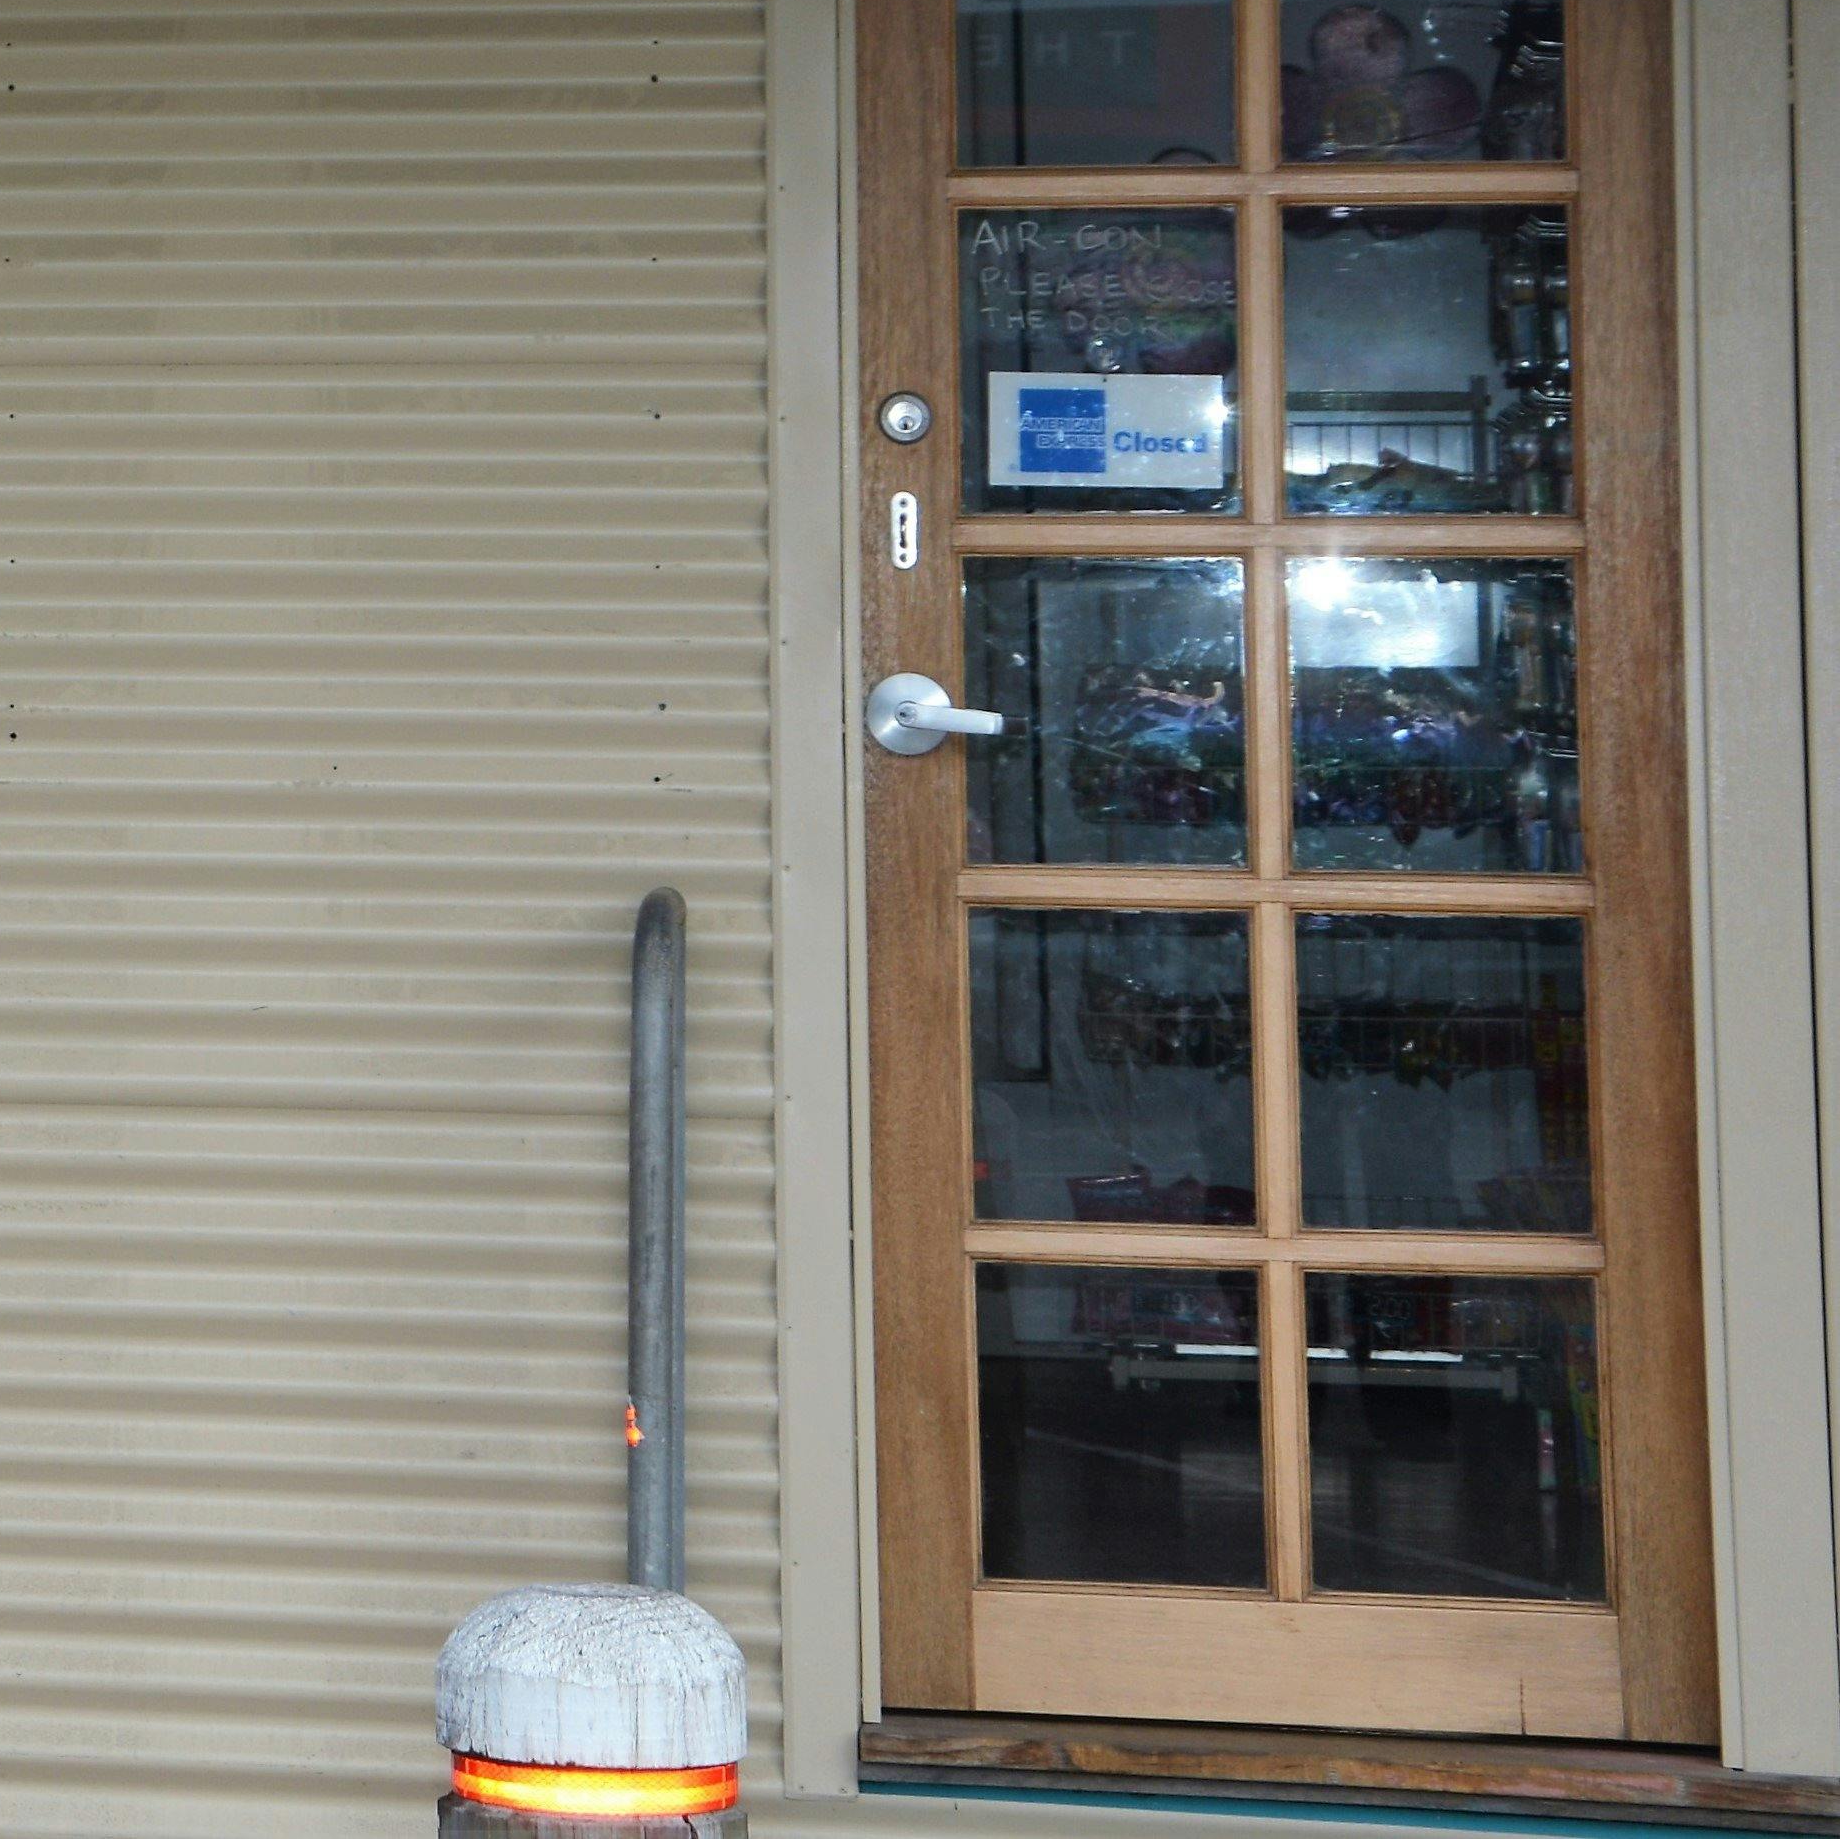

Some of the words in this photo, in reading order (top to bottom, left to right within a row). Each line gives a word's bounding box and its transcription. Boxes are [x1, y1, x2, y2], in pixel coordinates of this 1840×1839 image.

[980, 267, 1127, 298] PLEASE
[981, 307, 1045, 330] THE
[1067, 310, 1169, 340] DOOR
[1020, 416, 1104, 432] AMERICAN
[1036, 433, 1106, 449] EXPRESS
[1113, 431, 1207, 454] Closed
